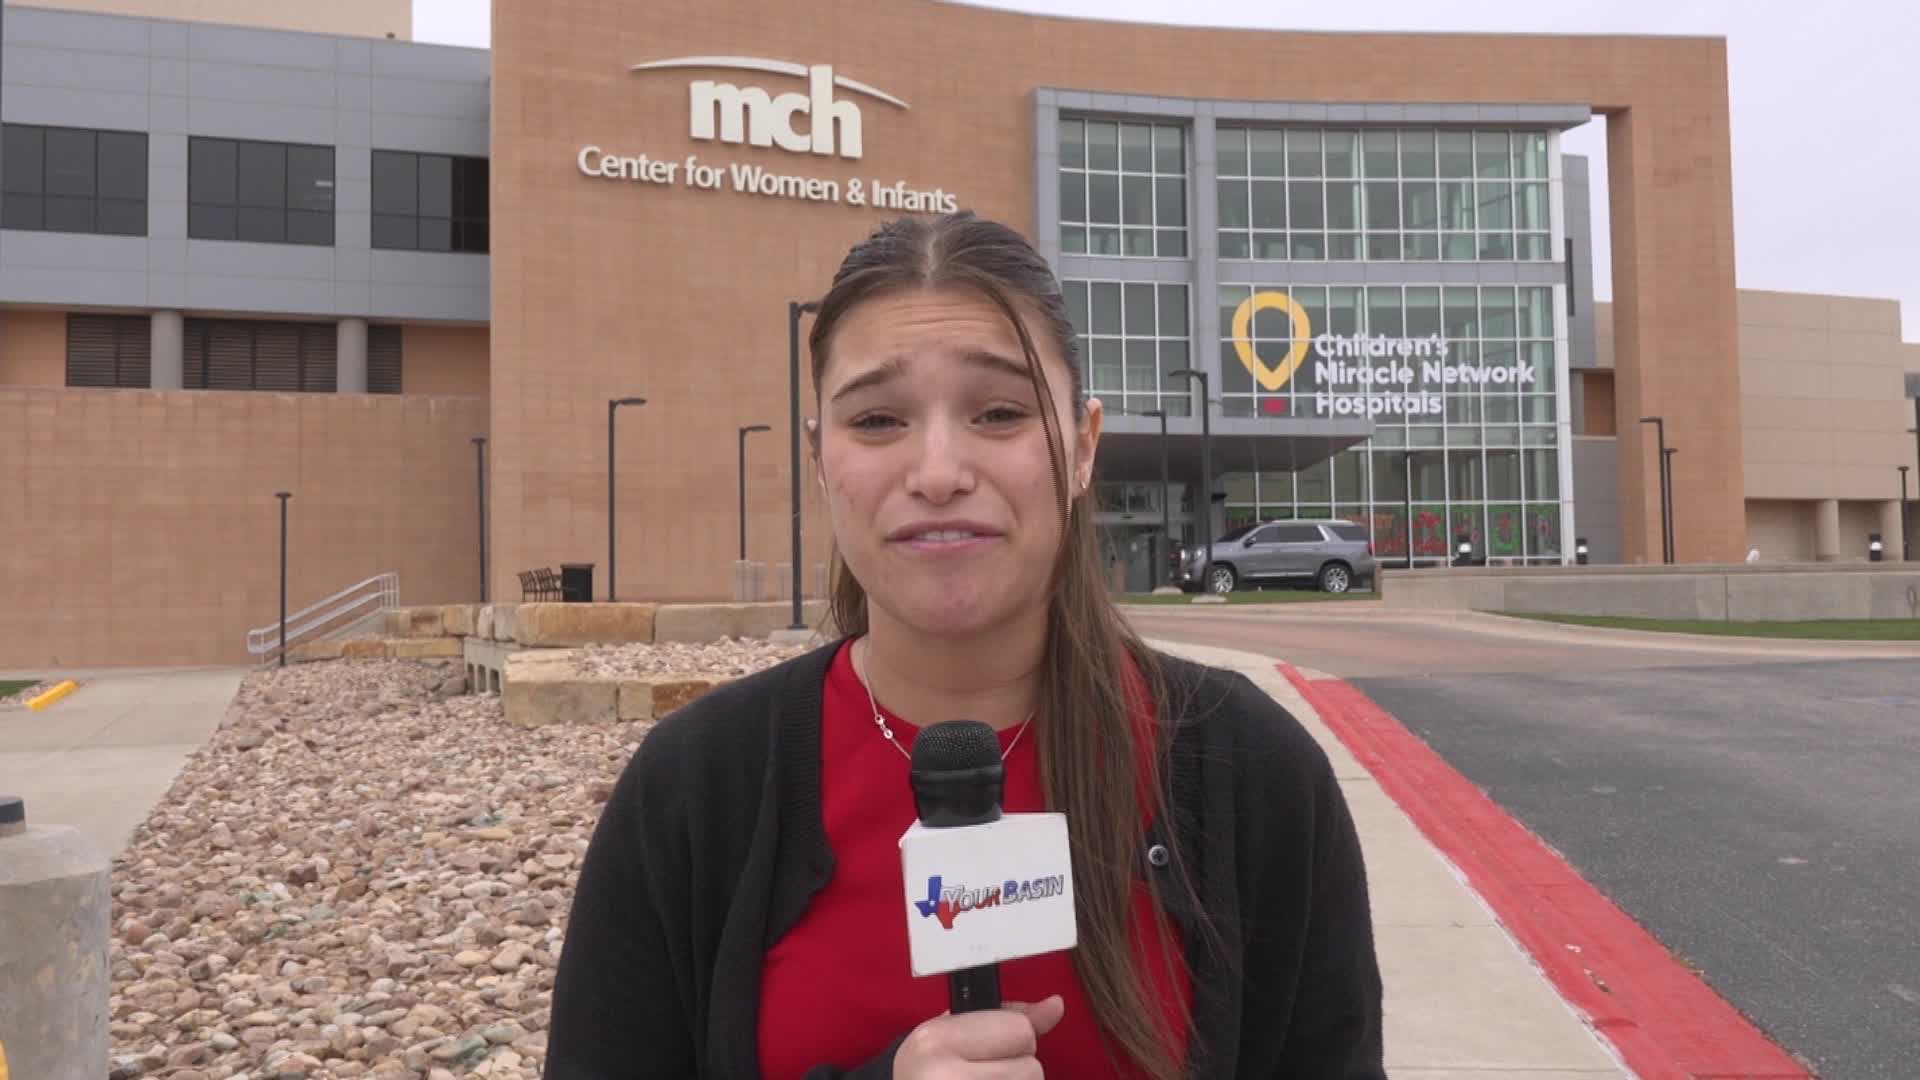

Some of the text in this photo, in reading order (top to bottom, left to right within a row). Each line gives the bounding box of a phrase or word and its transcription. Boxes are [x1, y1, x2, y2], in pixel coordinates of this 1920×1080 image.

[690, 65, 862, 158] mch
[577, 146, 958, 214] Center for Women & Infants
[1314, 333, 1449, 358] Children's
[1314, 360, 1536, 385] Miracle Network
[1316, 391, 1443, 415] Hospitals
